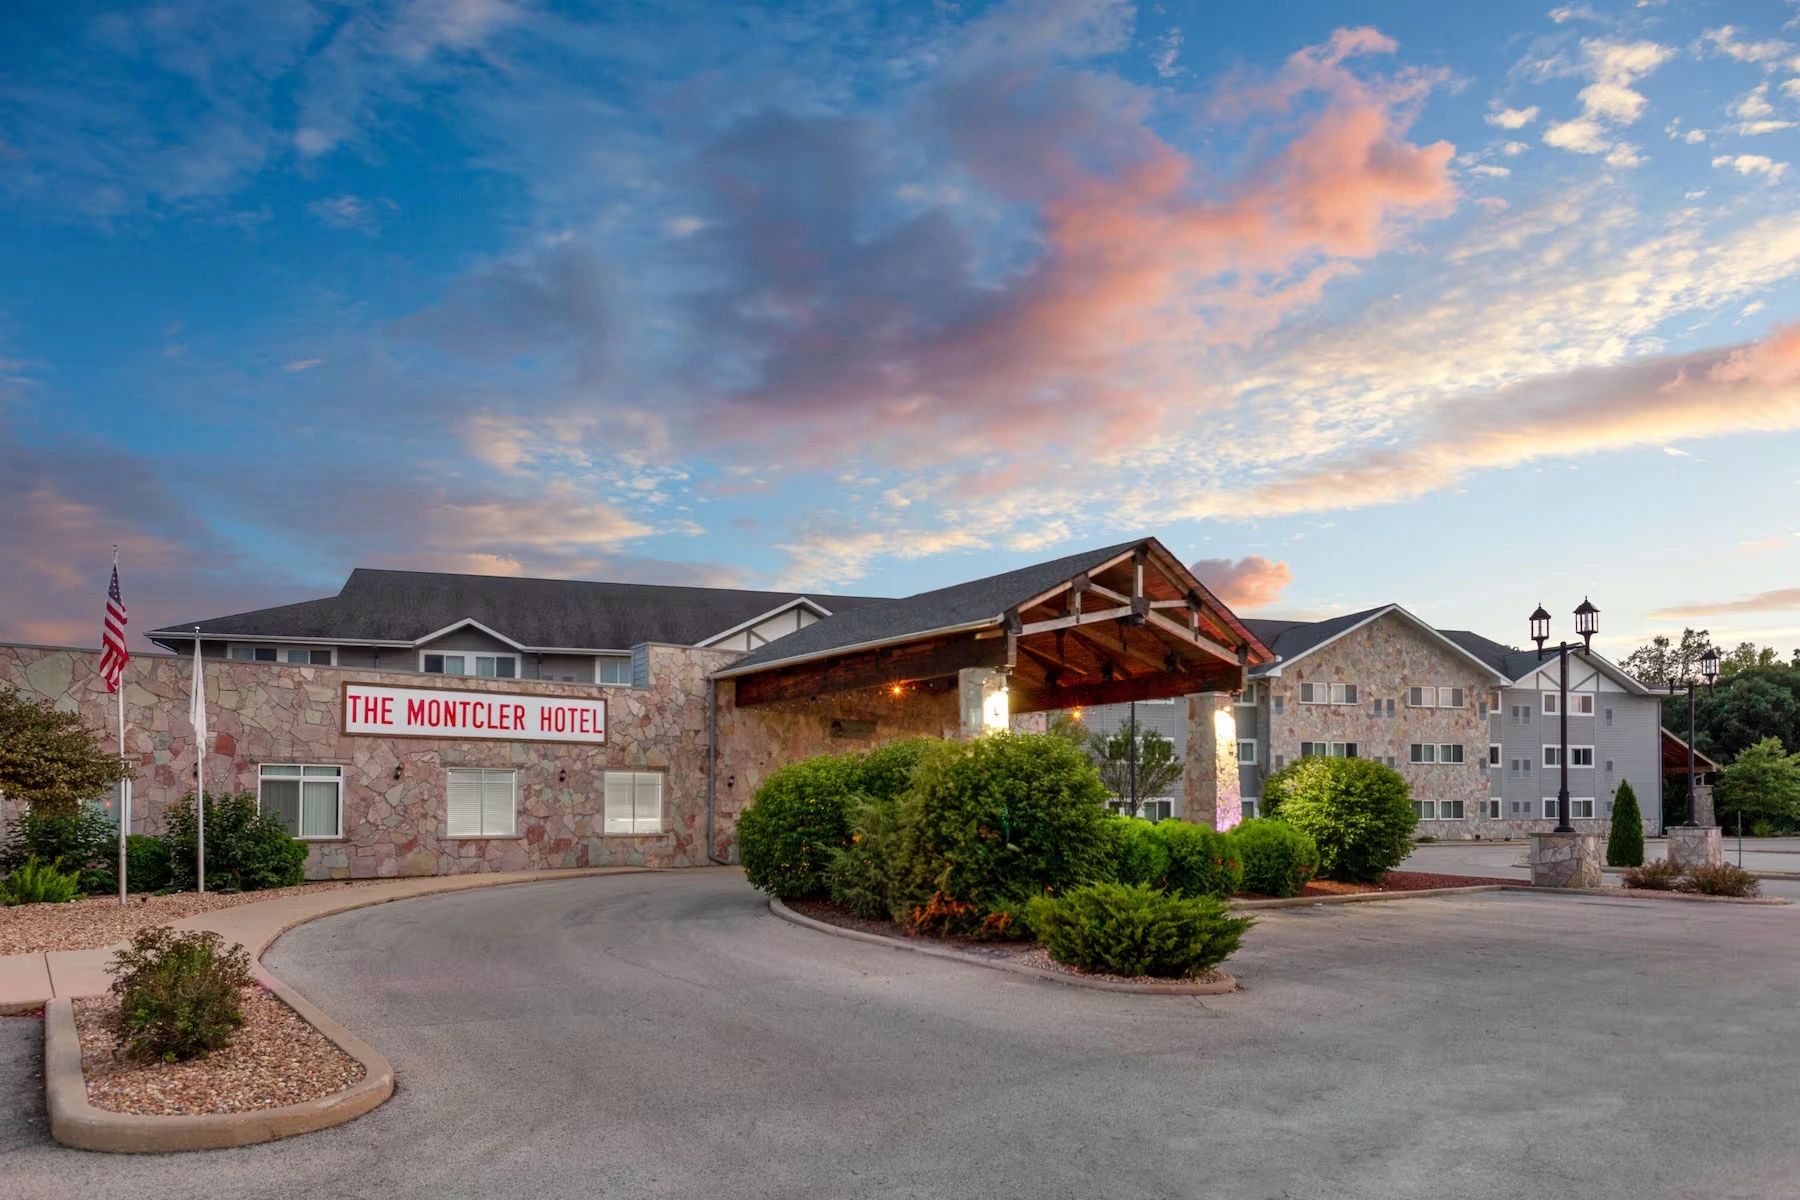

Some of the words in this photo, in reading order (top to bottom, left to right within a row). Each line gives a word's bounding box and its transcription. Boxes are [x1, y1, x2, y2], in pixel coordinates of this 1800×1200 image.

[348, 695, 394, 725] THE
[407, 699, 526, 731] MONTCLER
[540, 706, 603, 734] HOTEL
